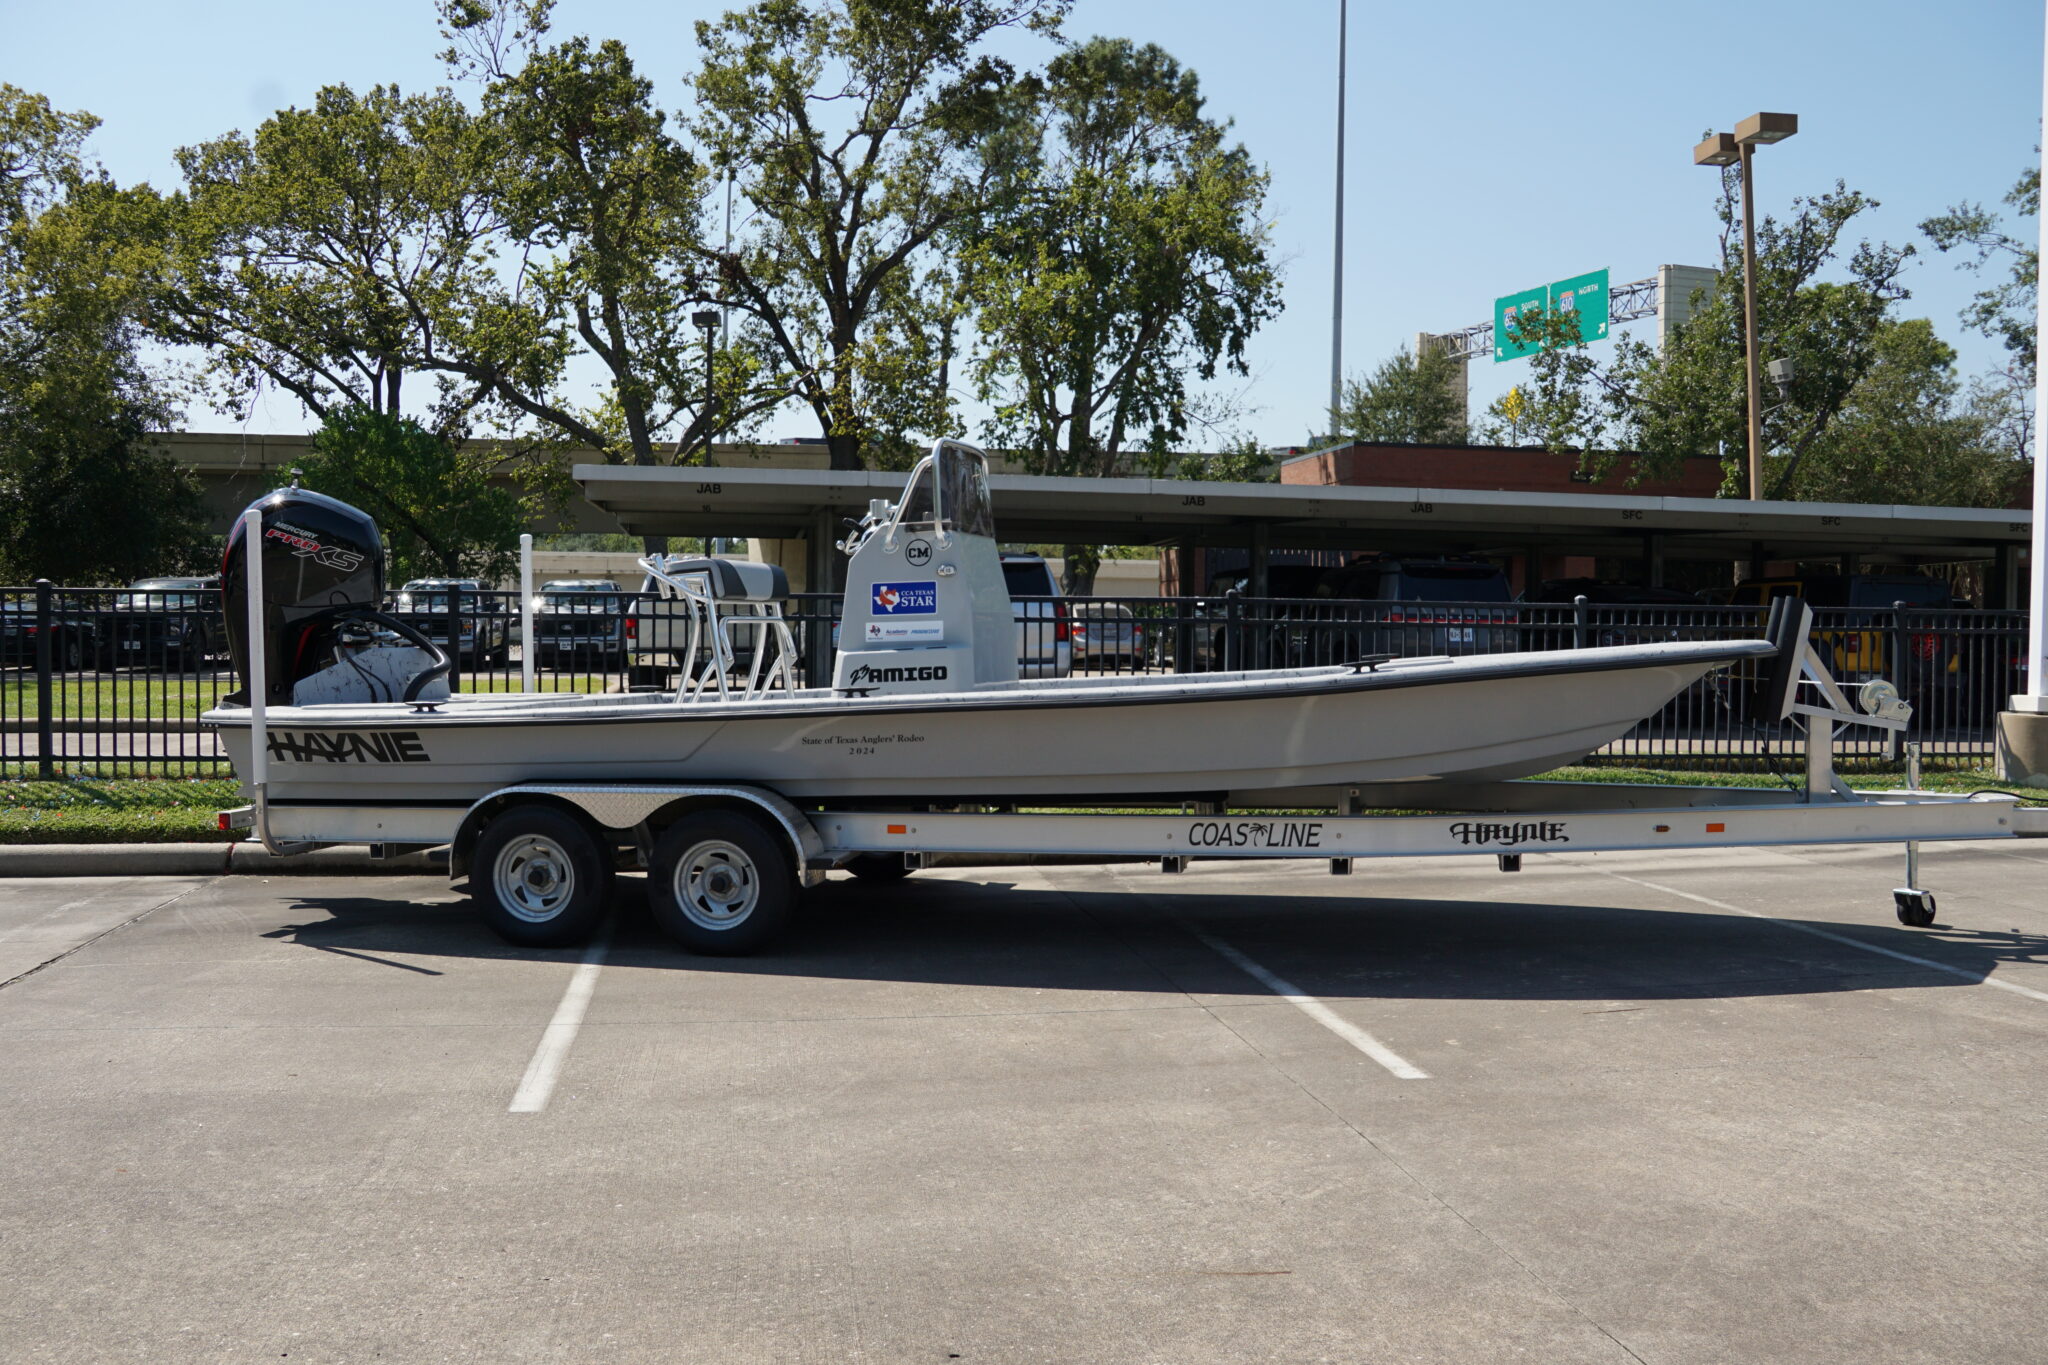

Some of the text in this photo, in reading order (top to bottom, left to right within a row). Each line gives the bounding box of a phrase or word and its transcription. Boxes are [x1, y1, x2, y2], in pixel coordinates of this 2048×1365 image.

[1579, 283, 1599, 295] NORTH
[1560, 297, 1573, 312] 610
[697, 483, 721, 494] JAB
[1182, 496, 1205, 506] JAB
[1410, 503, 1432, 513] JAB
[1622, 510, 1642, 520] SFC
[1821, 516, 1840, 526] SFC
[274, 521, 318, 539] MERCURY
[2009, 523, 2028, 532] SFC
[908, 547, 929, 558] CM
[901, 596, 934, 607] STAR
[868, 666, 947, 683] AMIGO
[802, 736, 822, 745] State
[824, 735, 834, 745] of
[835, 736, 858, 745] Texas
[897, 734, 925, 743] Rodeo
[267, 732, 431, 763] HAYNIE
[849, 747, 875, 755] 2024
